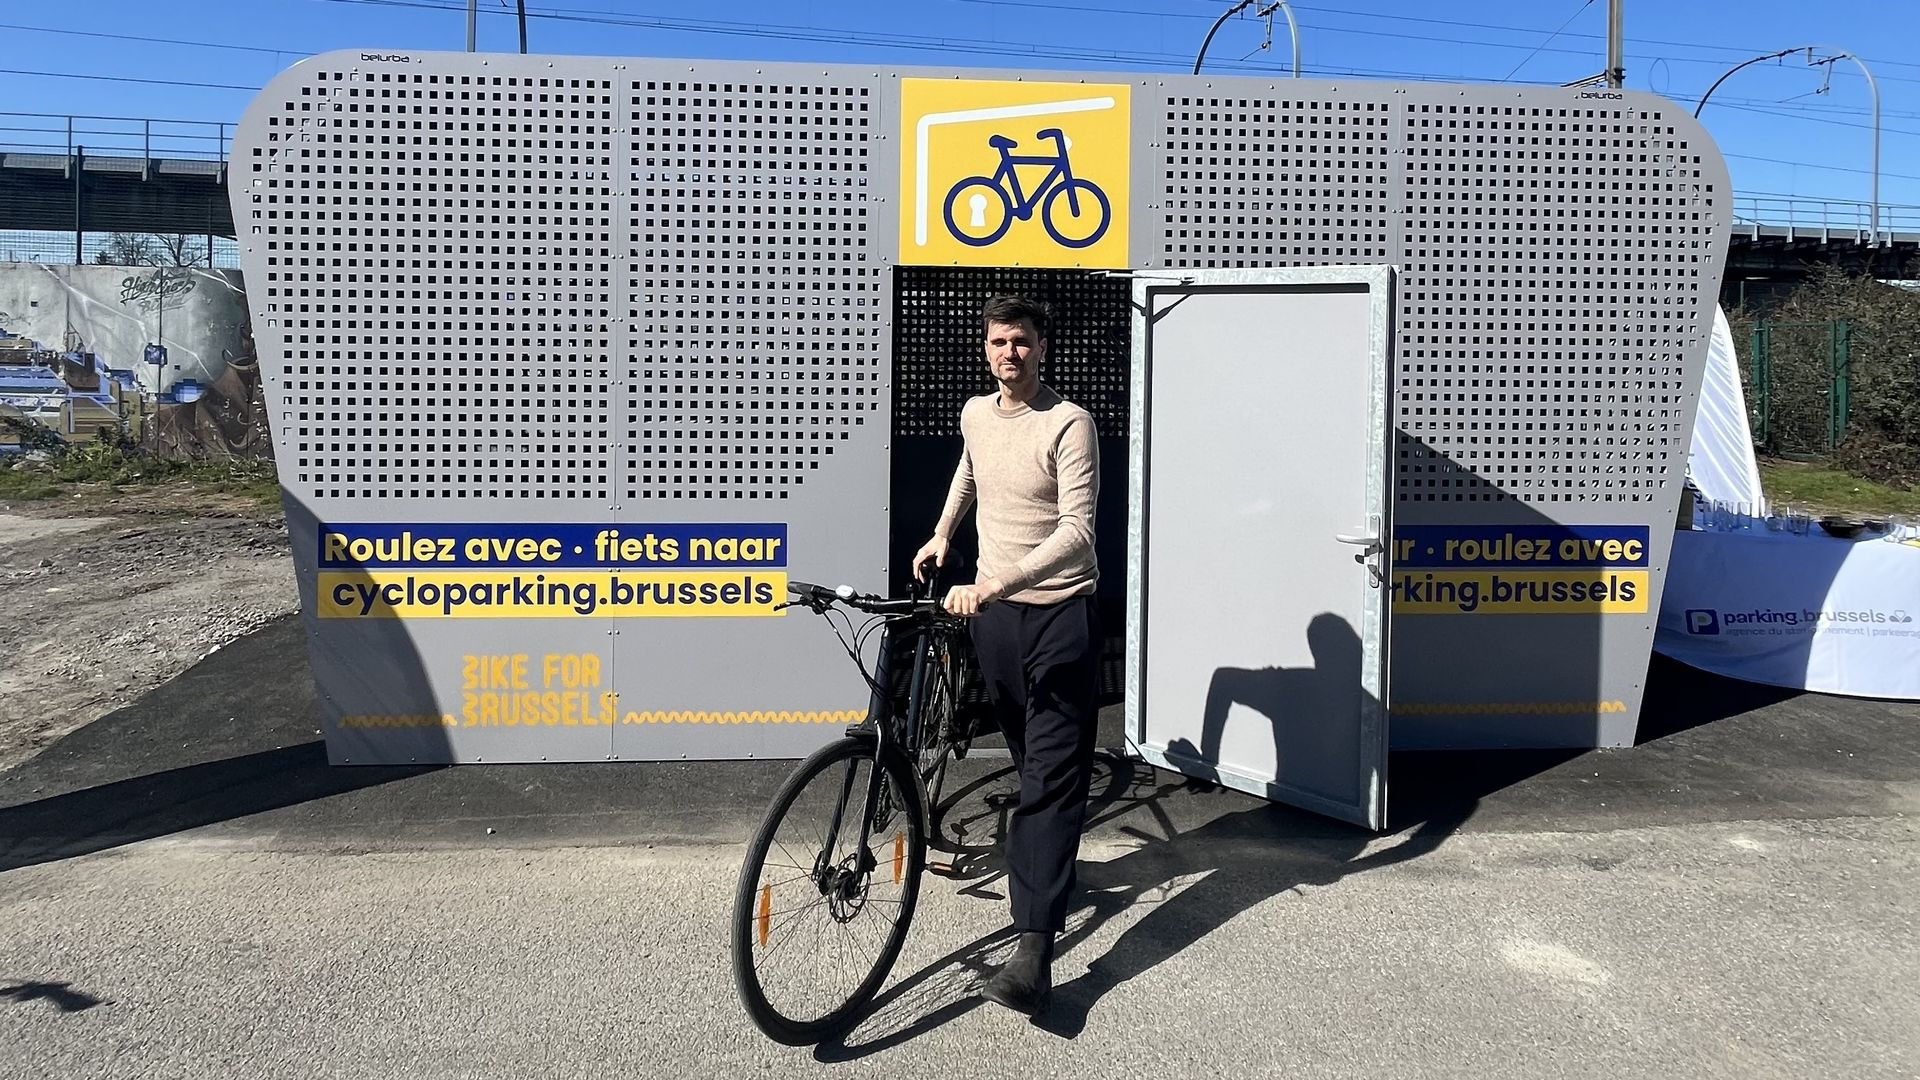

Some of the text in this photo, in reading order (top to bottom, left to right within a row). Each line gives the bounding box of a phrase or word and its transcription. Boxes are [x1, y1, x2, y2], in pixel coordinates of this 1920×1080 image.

[360, 53, 410, 63] belurba
[1580, 92, 1623, 100] belurba
[324, 529, 781, 562] Roulez avec fiets naar
[1445, 532, 1551, 561] roulez
[1558, 538, 1643, 561] avec
[332, 574, 774, 616] cycloparking.brussels
[1723, 608, 1887, 626] parking.brussels
[462, 653, 601, 689] BIKE FOR
[462, 691, 619, 728] BRUSSELS
